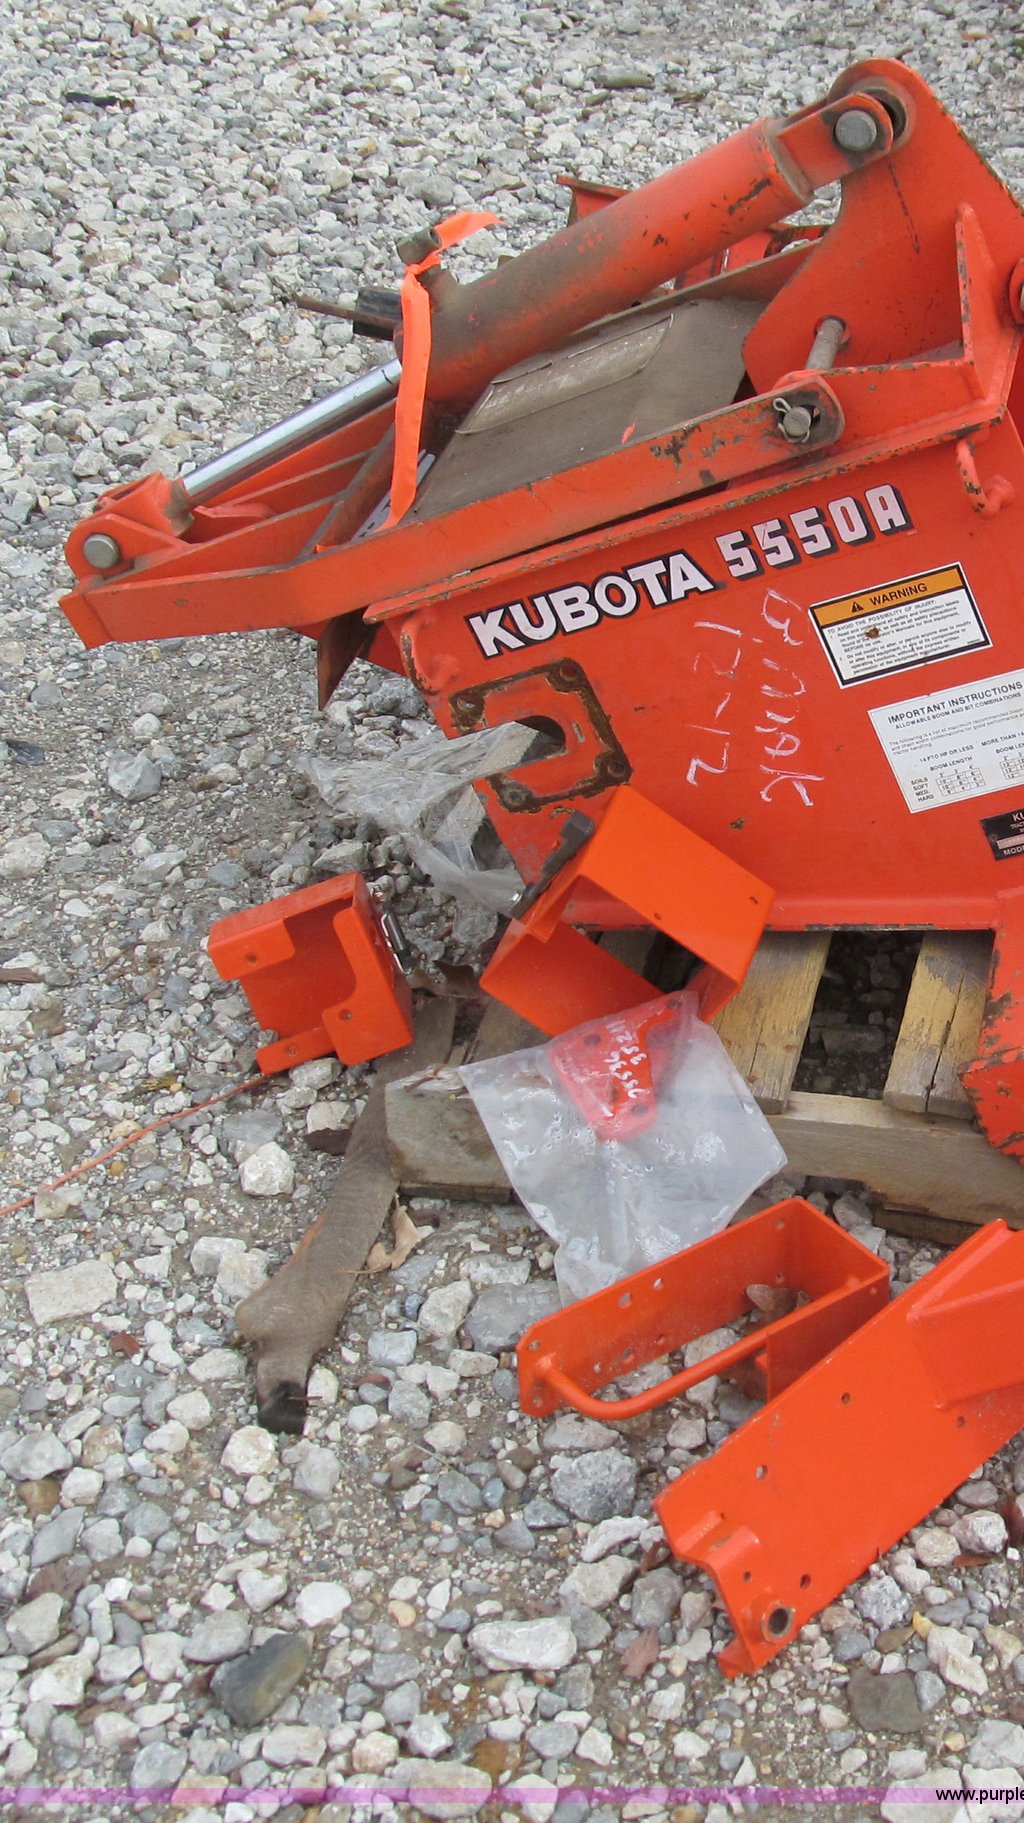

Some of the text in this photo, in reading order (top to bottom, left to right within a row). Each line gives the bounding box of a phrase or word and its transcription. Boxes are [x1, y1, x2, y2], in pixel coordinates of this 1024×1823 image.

[466, 484, 911, 659] KUBOTA 5550A
[869, 581, 928, 606] WARNING
[837, 623, 854, 631] AVOID
[867, 608, 903, 622] POSSIBILITY
[843, 643, 863, 652] BEFORE
[887, 680, 1023, 724] IMPORTANT INSTRUCTIONS
[894, 715, 931, 729] ALLOWABLE
[931, 710, 950, 719] BOOM
[950, 706, 964, 714] AND
[974, 691, 1021, 708] COMBINATIONS
[958, 744, 974, 752] LESS
[981, 738, 998, 746] MORE
[999, 733, 1016, 741] THAN
[995, 745, 1014, 753] BOOM
[929, 756, 972, 771] BOOM LENGTH
